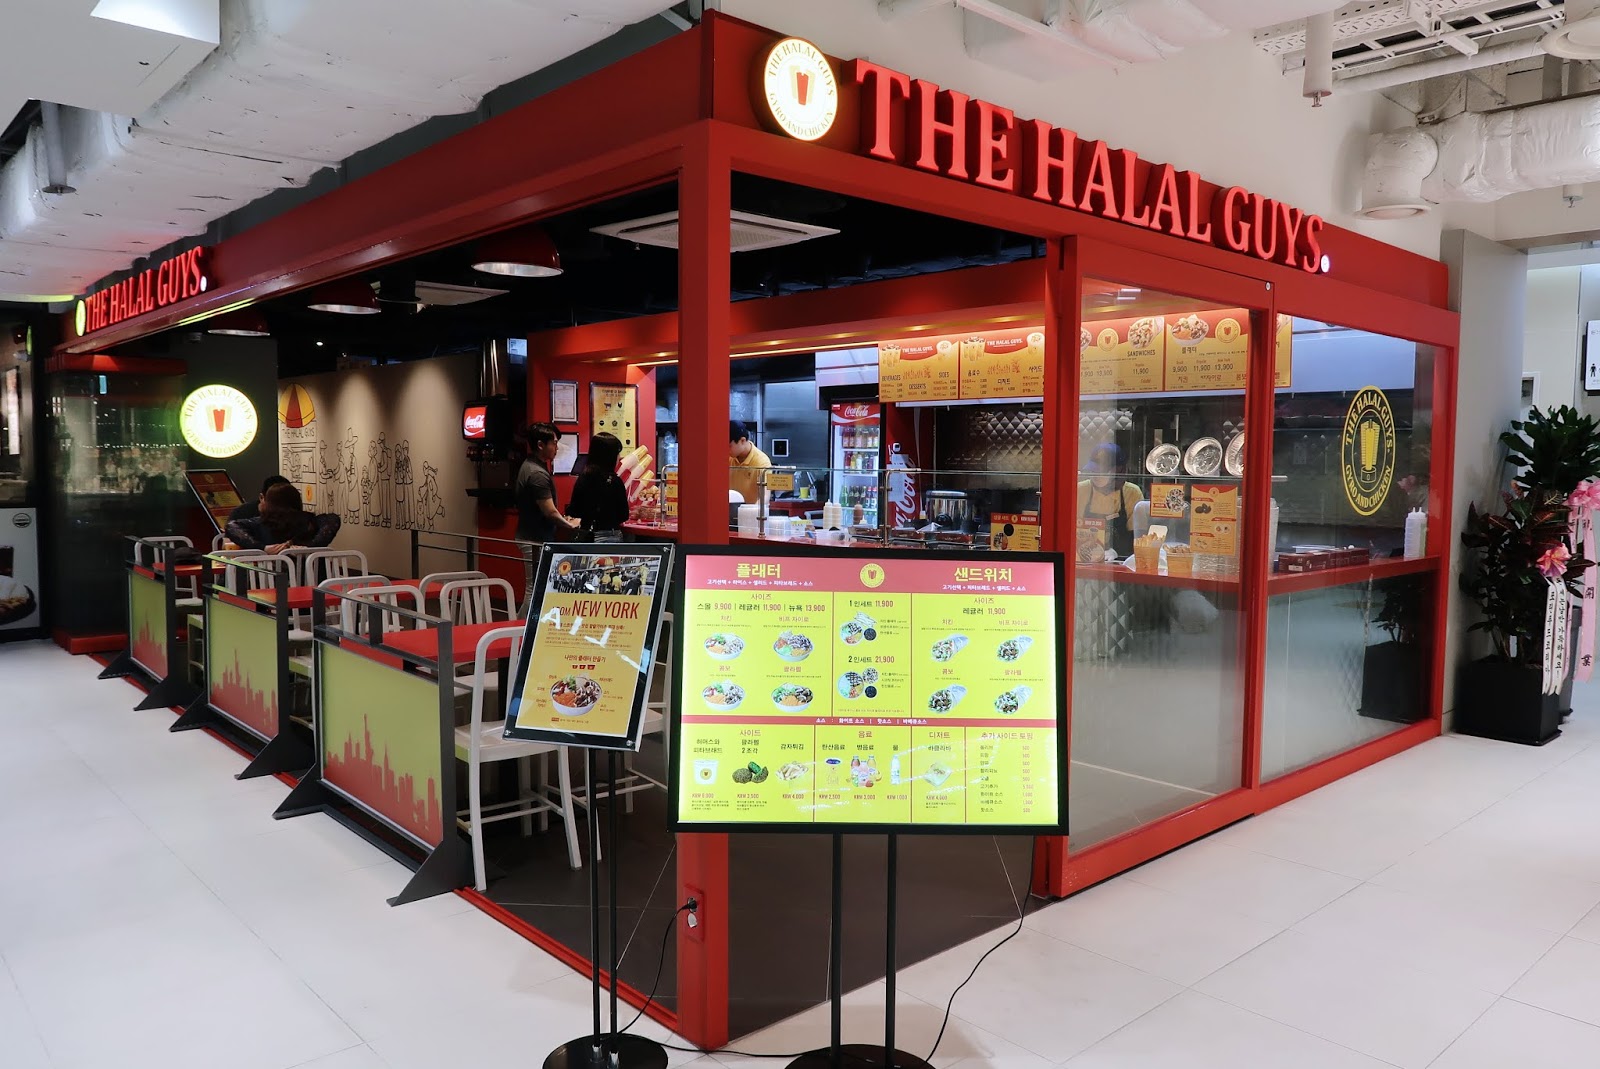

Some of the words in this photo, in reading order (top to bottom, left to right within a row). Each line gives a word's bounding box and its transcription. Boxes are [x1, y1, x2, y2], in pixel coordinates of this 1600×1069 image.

[769, 51, 783, 76] THE
[782, 43, 817, 61] HALAL
[818, 60, 834, 95] GUYS
[770, 93, 786, 121] GYRO
[786, 121, 804, 135] AND
[804, 112, 833, 136] CHICKEN
[856, 58, 1014, 191] THE
[1033, 118, 1211, 243] HALAL
[85, 288, 109, 332] THE
[109, 268, 154, 324] HALAL
[1193, 364, 1210, 372] 11,900
[1345, 408, 1359, 446] THE
[1356, 391, 1382, 414] HALAL
[1345, 464, 1358, 498] GYRO
[1356, 495, 1369, 508] AND
[1368, 465, 1391, 508] CHICKEN
[736, 563, 781, 578] 플래터
[953, 567, 1012, 582] 샌드위치
[552, 606, 571, 616] OM
[571, 600, 602, 617] NEW
[604, 601, 640, 620] YORK
[738, 603, 760, 611] 레귤러
[763, 603, 781, 611] 11,900
[788, 604, 803, 612] 뉴욕
[805, 604, 826, 612] 13,900
[962, 607, 984, 615] 레귤러
[987, 607, 1006, 615] 11,900
[592, 655, 607, 663] 만들기
[875, 655, 895, 663] 21,900
[1020, 732, 1033, 740] 토핑
